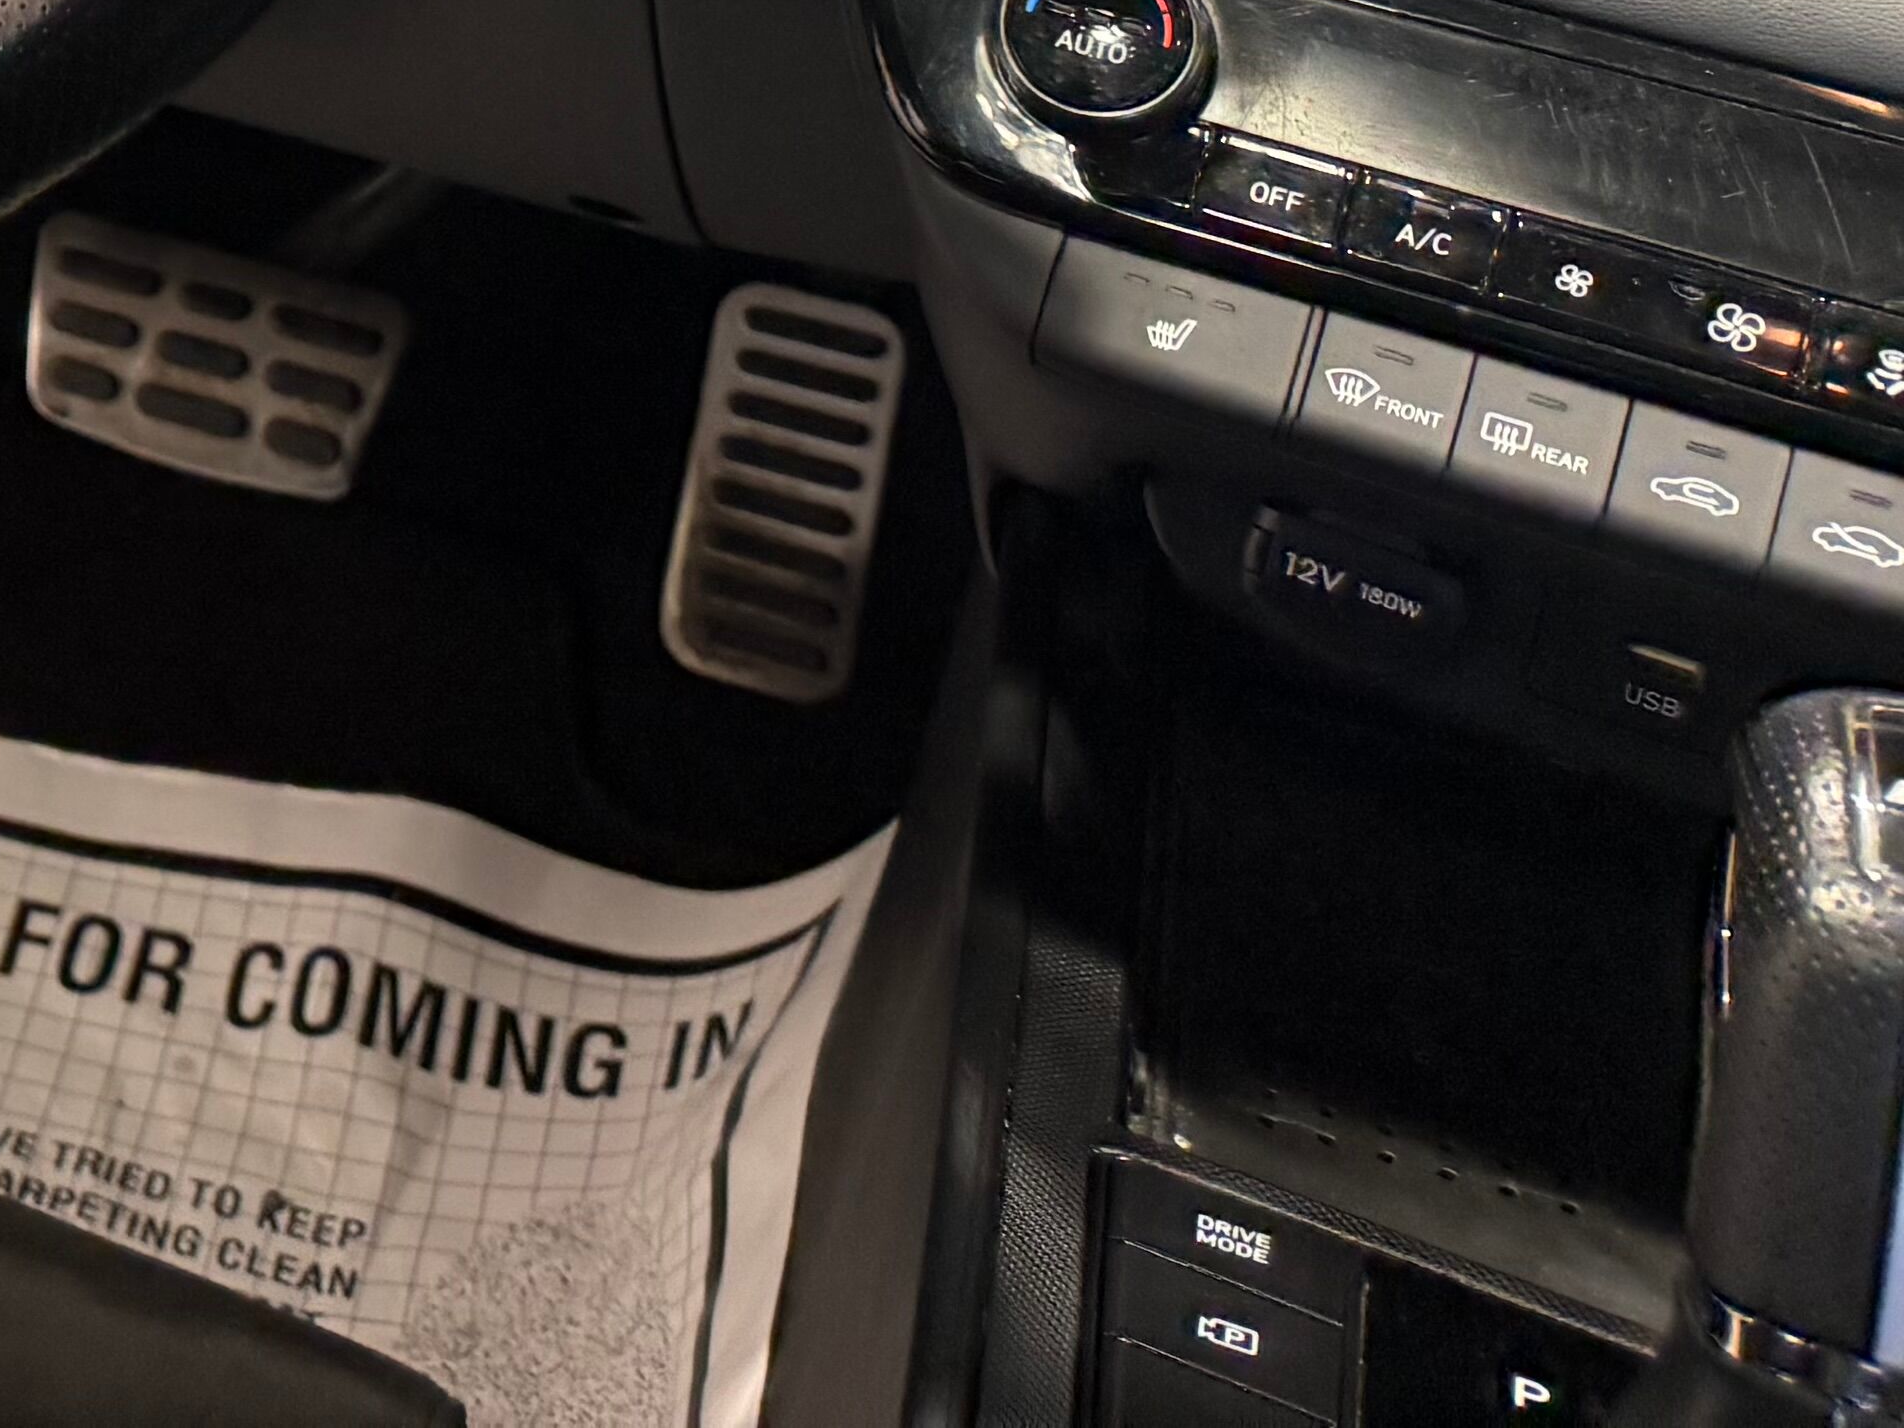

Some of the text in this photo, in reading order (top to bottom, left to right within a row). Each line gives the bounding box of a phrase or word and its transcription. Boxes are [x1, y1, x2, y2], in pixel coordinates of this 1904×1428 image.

[1054, 29, 1128, 64] AUTO
[1249, 181, 1305, 214] OFF
[1395, 222, 1452, 258] A/C
[1373, 396, 1444, 430] FRONT
[1530, 442, 1590, 475] REAR
[1285, 551, 1423, 619] 12V 180W
[1624, 686, 1680, 718] USB
[224, 942, 628, 1100] COMING
[662, 997, 754, 1090] IN
[50, 1139, 171, 1203] TRIED
[192, 1177, 242, 1219] TO
[256, 1188, 368, 1249] KEEP
[1196, 1212, 1273, 1251] DRIVE
[1196, 1228, 1270, 1265] MODE
[216, 1238, 360, 1300] CLEAN
[1512, 1373, 1550, 1409] P
